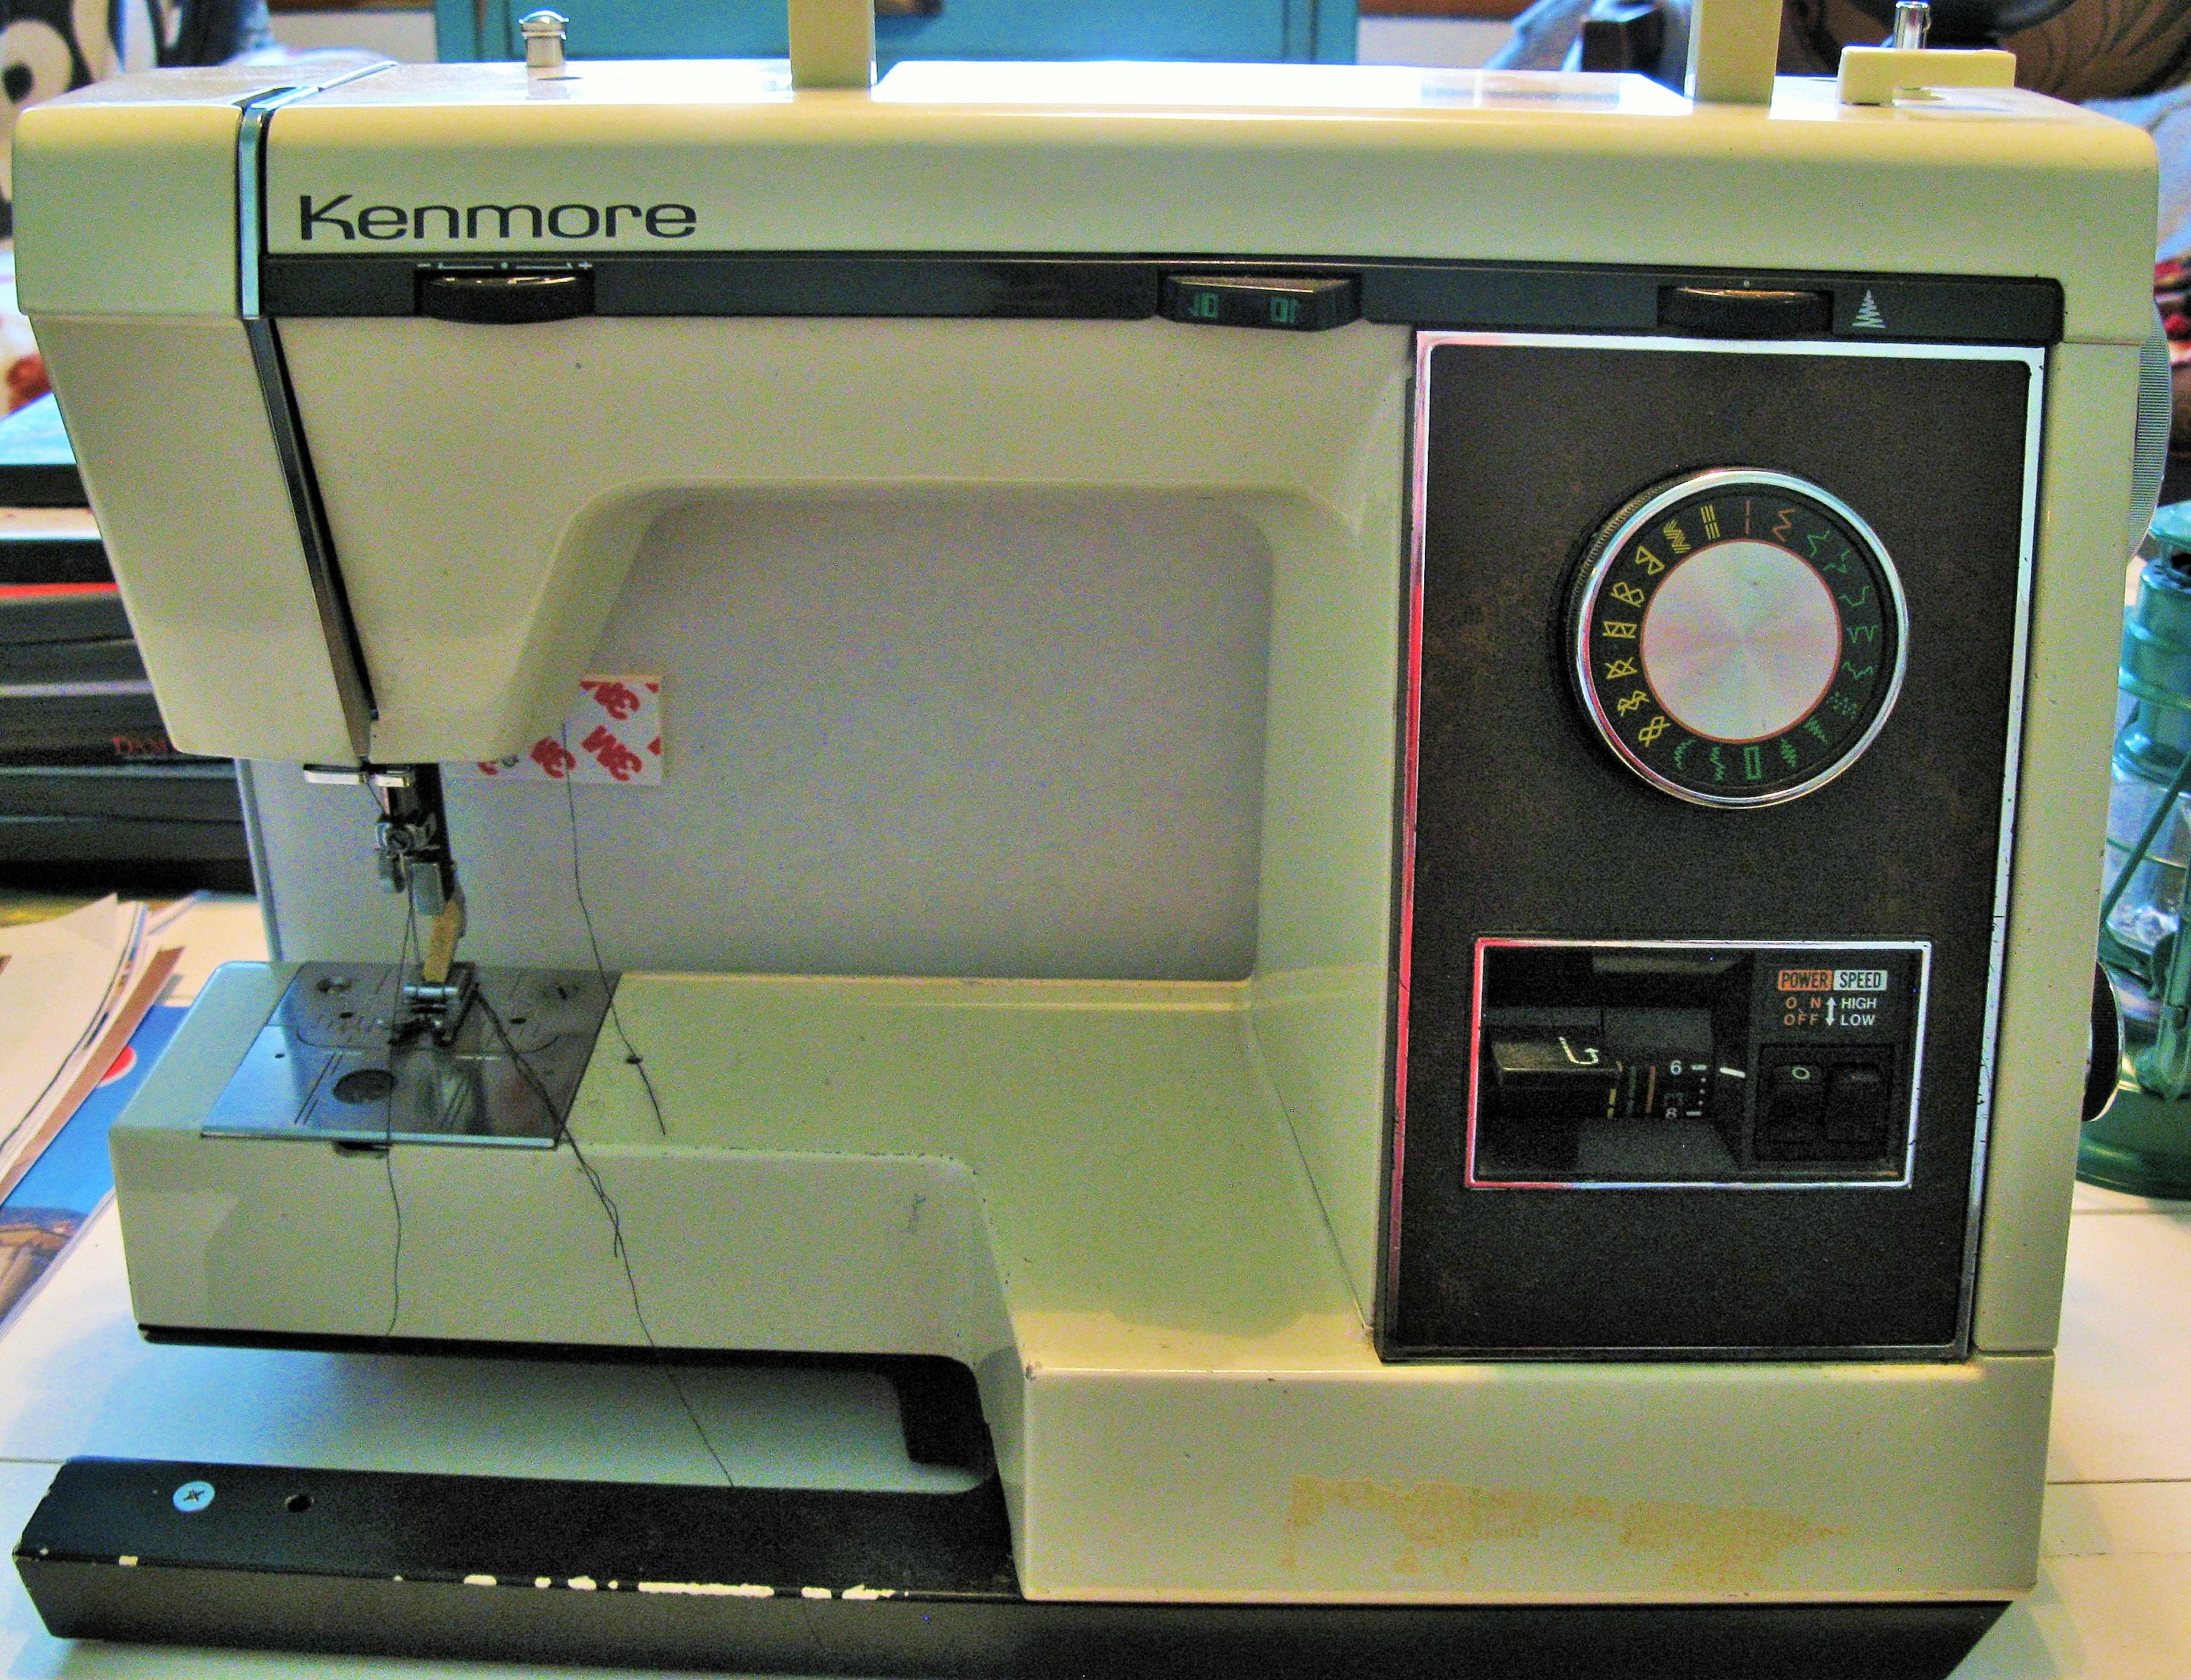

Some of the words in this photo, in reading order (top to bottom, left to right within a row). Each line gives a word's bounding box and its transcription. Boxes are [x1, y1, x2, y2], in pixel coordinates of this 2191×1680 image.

[299, 194, 697, 240] Kenmore
[1781, 971, 1828, 988] POWER
[1839, 971, 1881, 988] SPEED
[1840, 996, 1878, 1009] HIGH
[1783, 1013, 1819, 1026] OFF
[1840, 1013, 1876, 1026] LOW
[1670, 1060, 1682, 1075] 6
